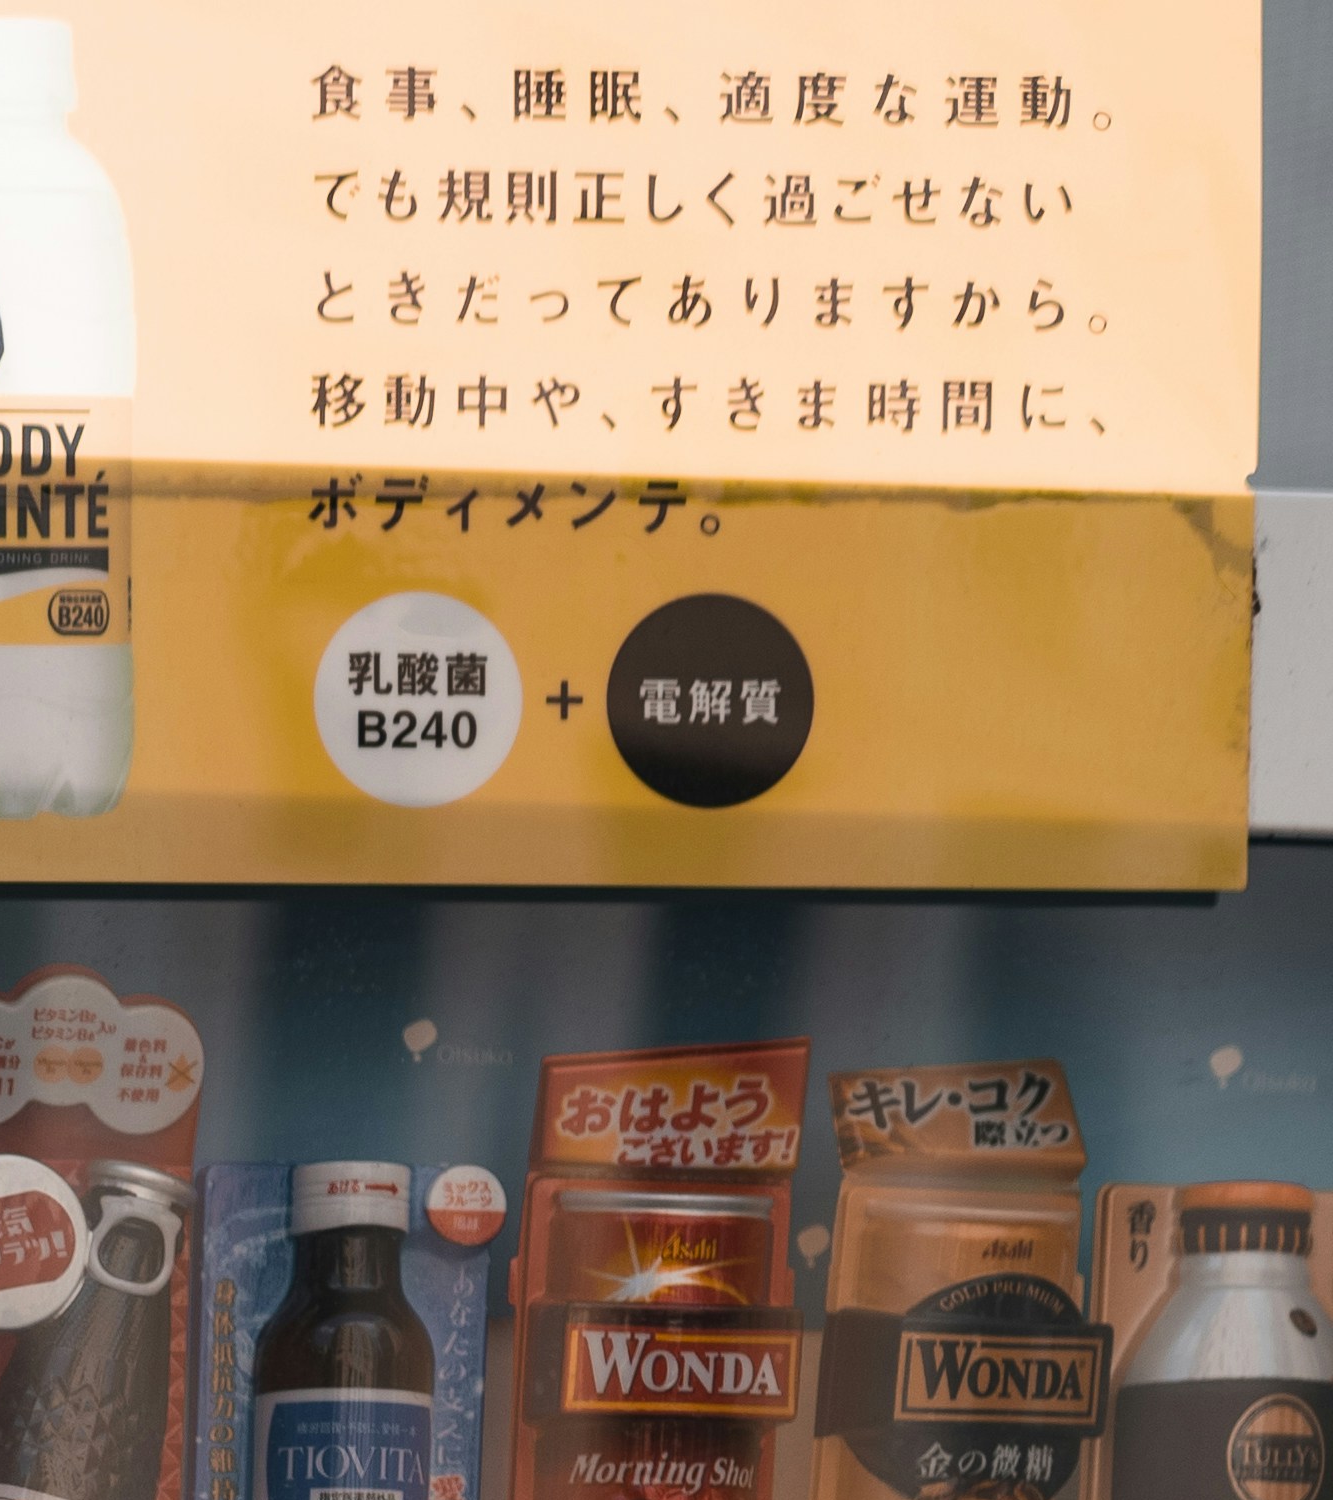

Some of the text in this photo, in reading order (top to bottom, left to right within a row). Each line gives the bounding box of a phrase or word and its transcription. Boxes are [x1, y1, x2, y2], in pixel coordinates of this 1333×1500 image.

[311, 64, 1116, 132] 食事、睡眠、適度な運動。
[311, 168, 1073, 227] でも規則正しく過ごせない
[313, 269, 1108, 335] ときだってありますから。
[310, 371, 1109, 434] 移動中や、すきま時間に、
[307, 473, 722, 539] ボディメンテ。
[50, 553, 91, 564] DRINK
[58, 605, 104, 628] B240
[348, 651, 489, 700] 乳酸菌
[637, 678, 782, 725] 電解質
[357, 709, 478, 750] B240
[562, 1080, 769, 1134] おはよう
[849, 1072, 1051, 1130] キレ・コク
[618, 1129, 798, 1167] ございます!
[278, 1446, 425, 1485] TIOVITA
[917, 1442, 1053, 1482] 金の微糖
